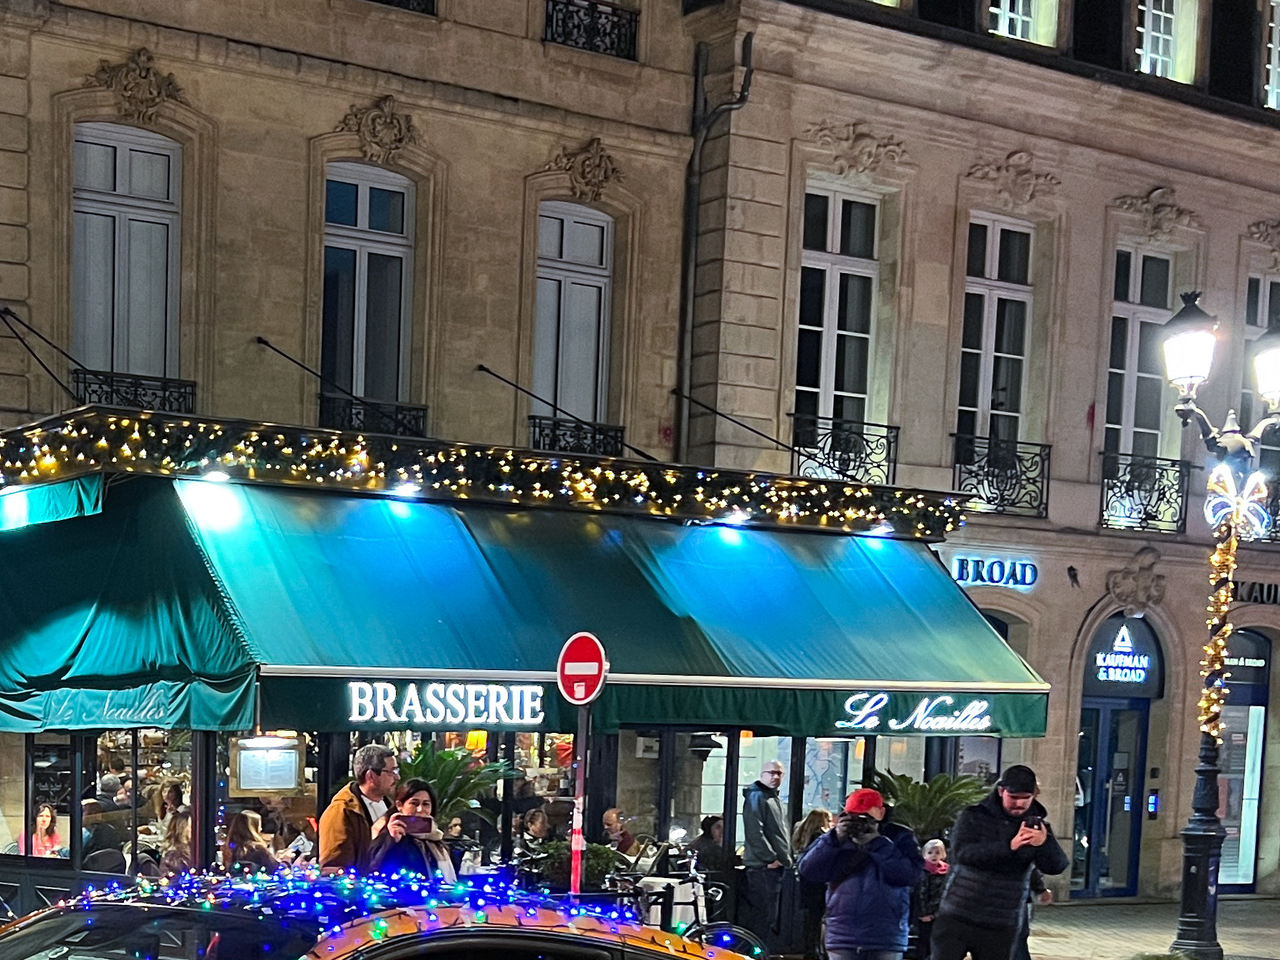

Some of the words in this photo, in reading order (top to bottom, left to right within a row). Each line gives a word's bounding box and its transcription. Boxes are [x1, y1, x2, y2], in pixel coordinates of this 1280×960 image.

[956, 558, 1038, 585] BROAD
[1236, 581, 1280, 603] KAU
[1095, 652, 1150, 669] KAUFMAN
[1097, 667, 1108, 681] &
[1108, 667, 1147, 683] BROAD
[348, 680, 545, 725] BRASSERIE
[834, 692, 889, 729] Le
[887, 695, 992, 730] Noailles
